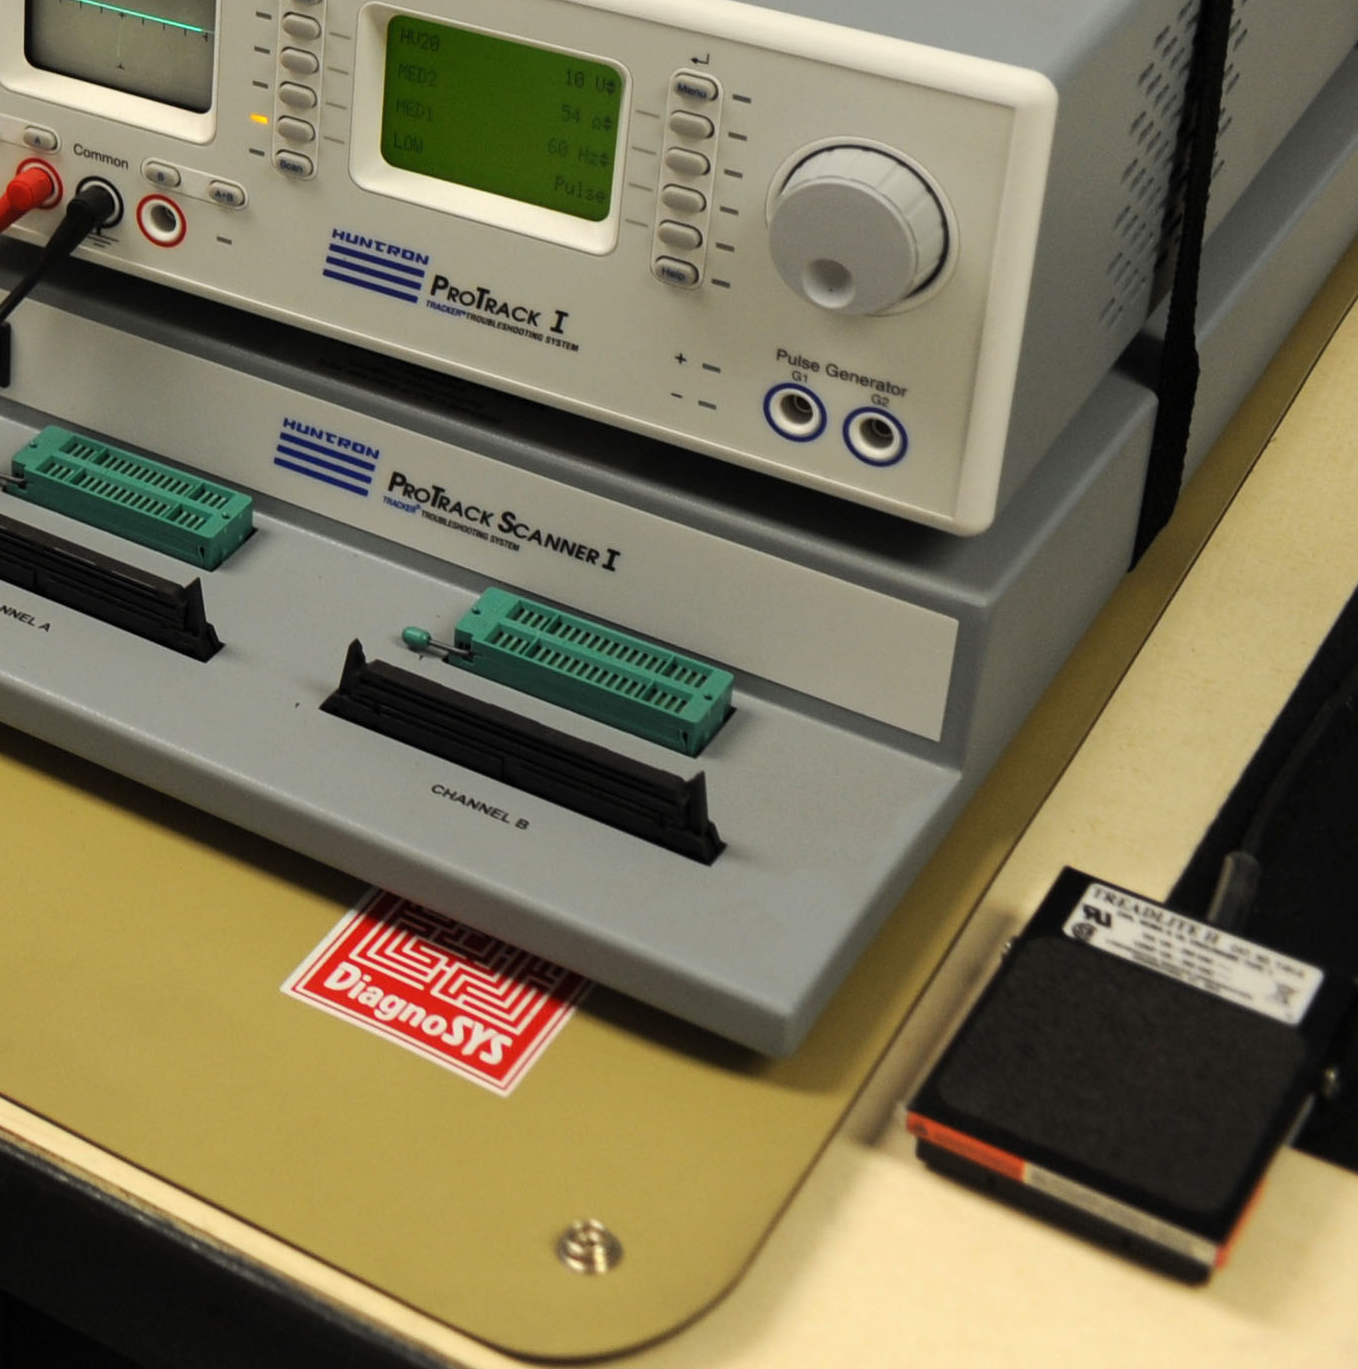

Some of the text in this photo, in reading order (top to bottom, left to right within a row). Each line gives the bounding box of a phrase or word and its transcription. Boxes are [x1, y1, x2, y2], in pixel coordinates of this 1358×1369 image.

[398, 62, 438, 88] MED2
[565, 69, 584, 89] 10
[676, 82, 708, 99] Menu
[395, 97, 433, 123] MED1
[560, 104, 581, 125] 54
[393, 133, 424, 154] LOW
[72, 142, 129, 171] Common
[279, 159, 303, 174] Scan
[214, 189, 234, 202] A+B
[553, 176, 606, 203] Pulse
[332, 228, 430, 266] HUNTRON
[549, 309, 570, 335] I
[545, 335, 580, 352] SYSTEM
[775, 347, 909, 399] Pulse Generator
[791, 370, 809, 385] G1
[870, 393, 891, 409] G2
[282, 416, 380, 460] HUNTRON
[489, 534, 521, 552] SYSTEM
[600, 546, 622, 573] I
[37, 622, 52, 633] A
[430, 783, 530, 831] CHANNEL B
[322, 960, 514, 1067] DiagnoSYS
